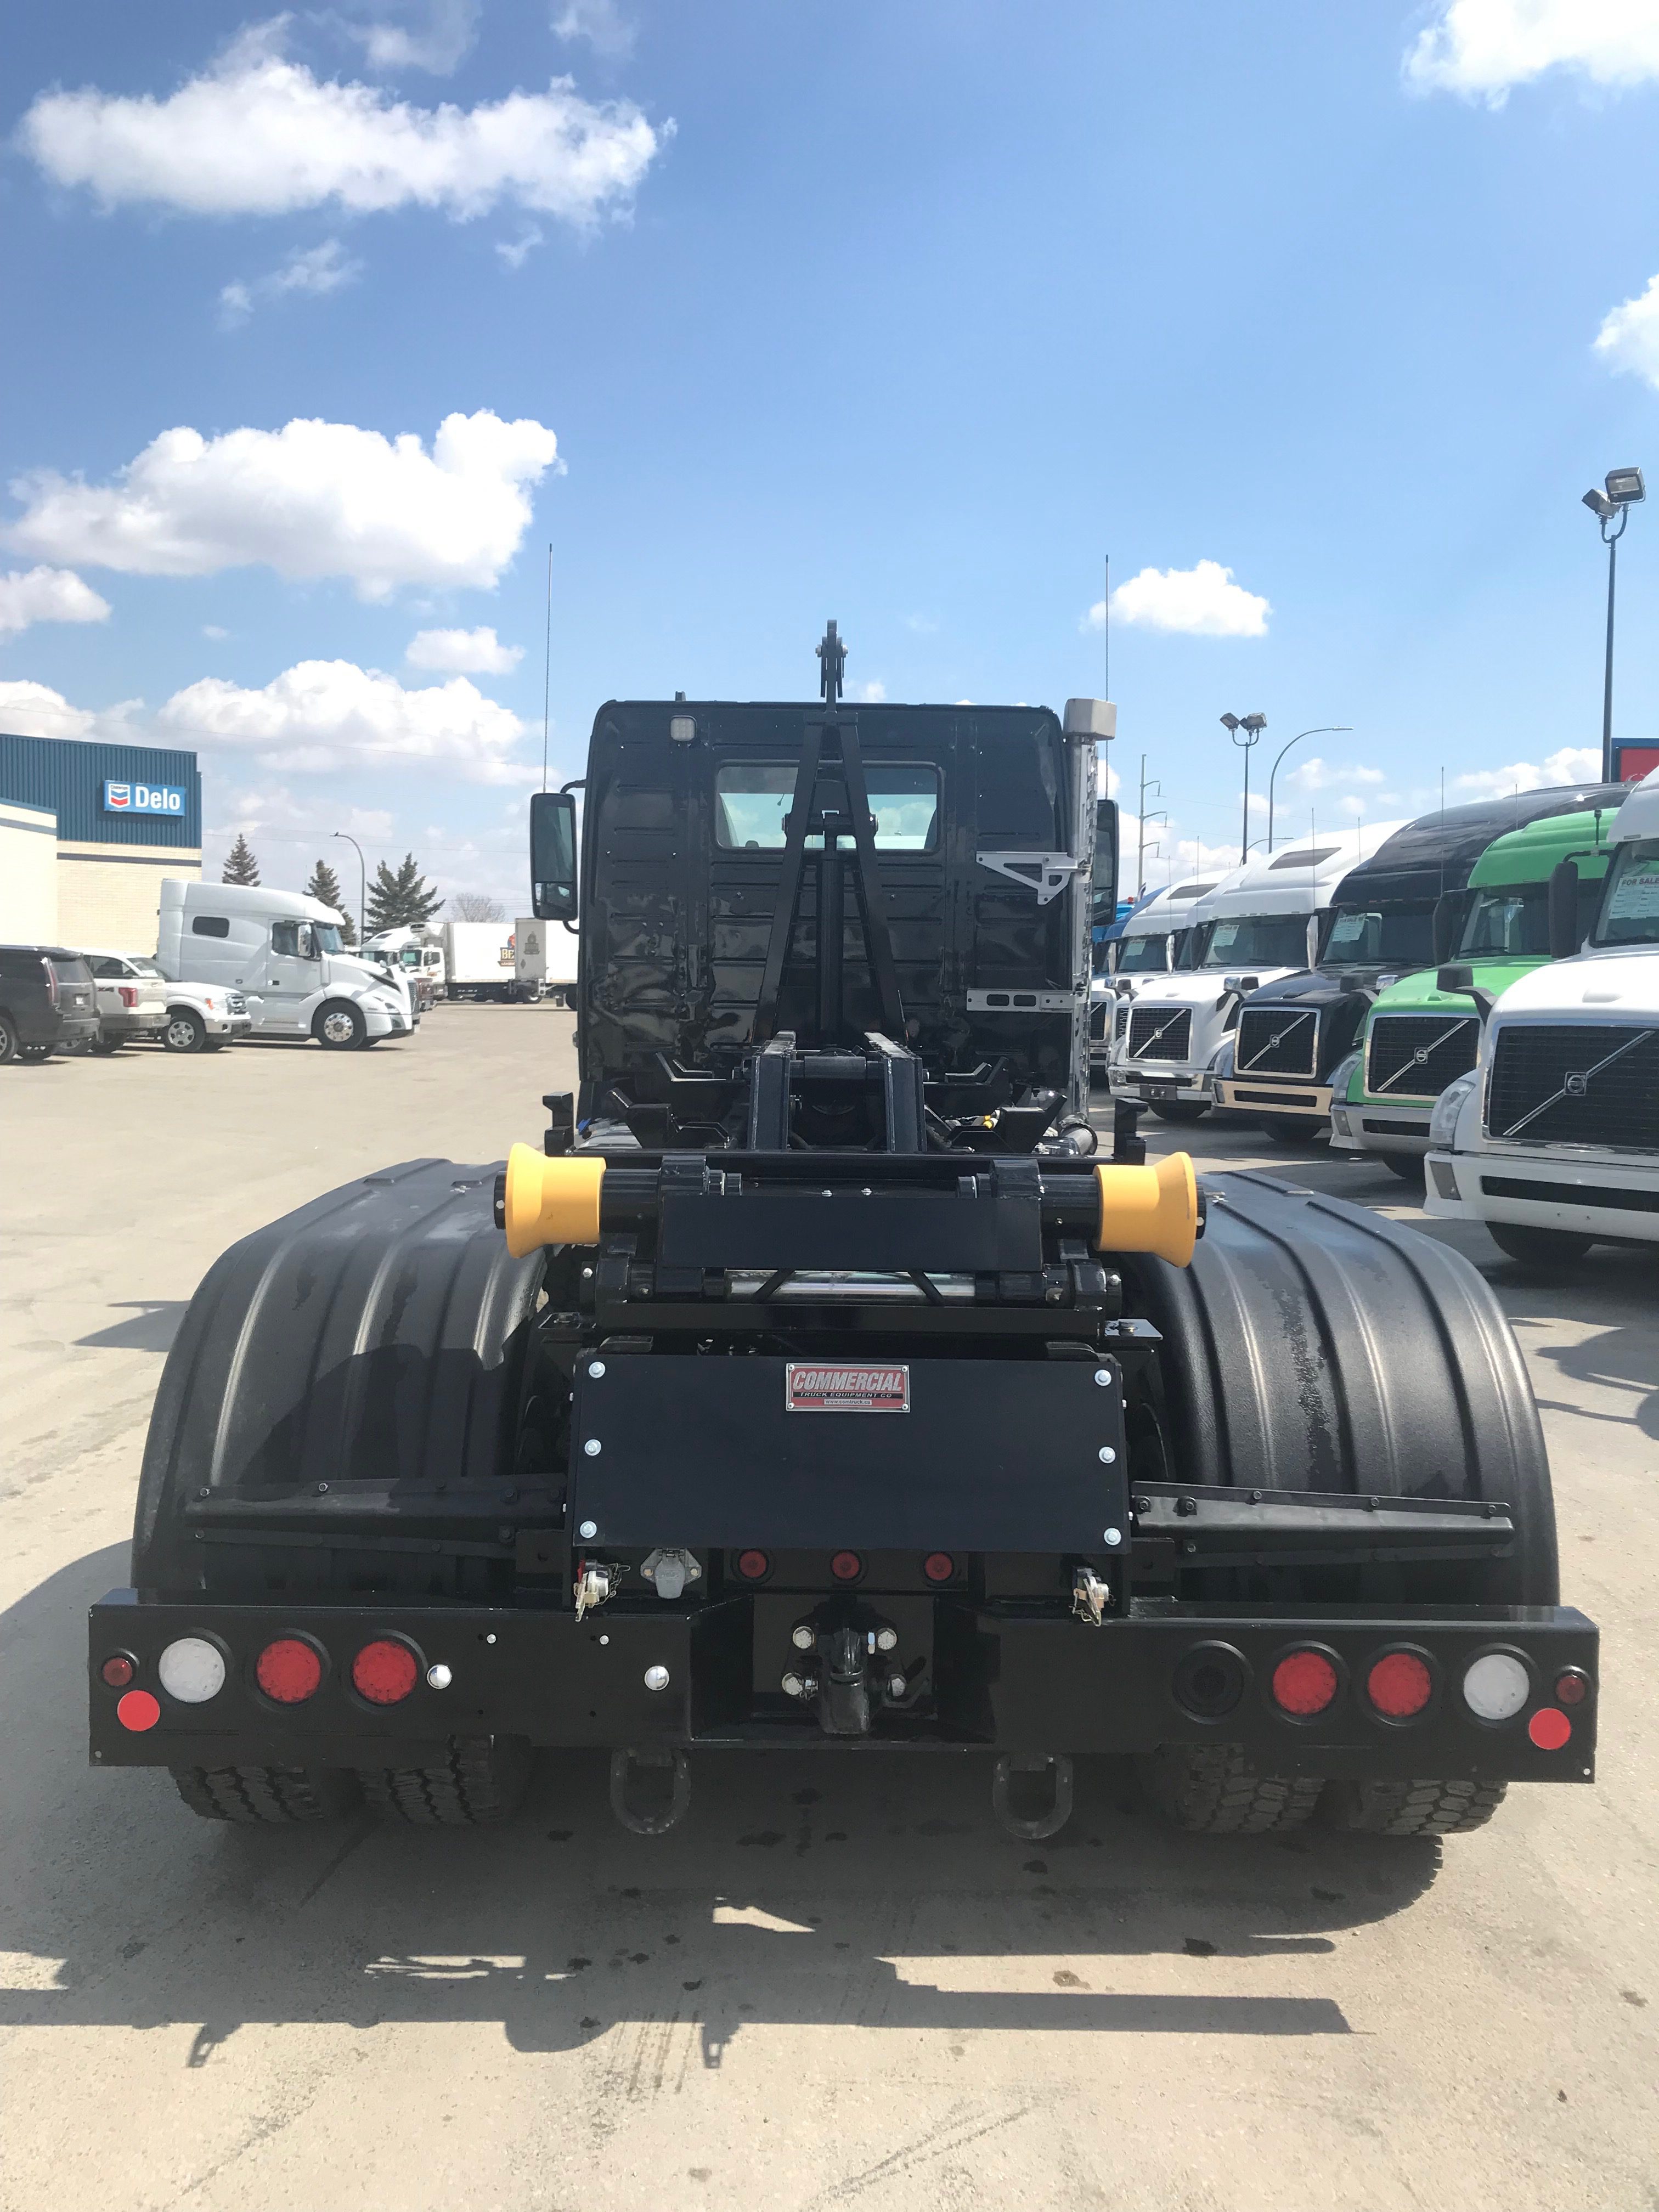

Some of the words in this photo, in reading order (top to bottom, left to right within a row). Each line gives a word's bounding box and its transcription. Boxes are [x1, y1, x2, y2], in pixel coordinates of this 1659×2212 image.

[136, 786, 180, 810] Delo
[501, 949, 515, 959] BE
[793, 1372, 901, 1391] COMMERCIAL
